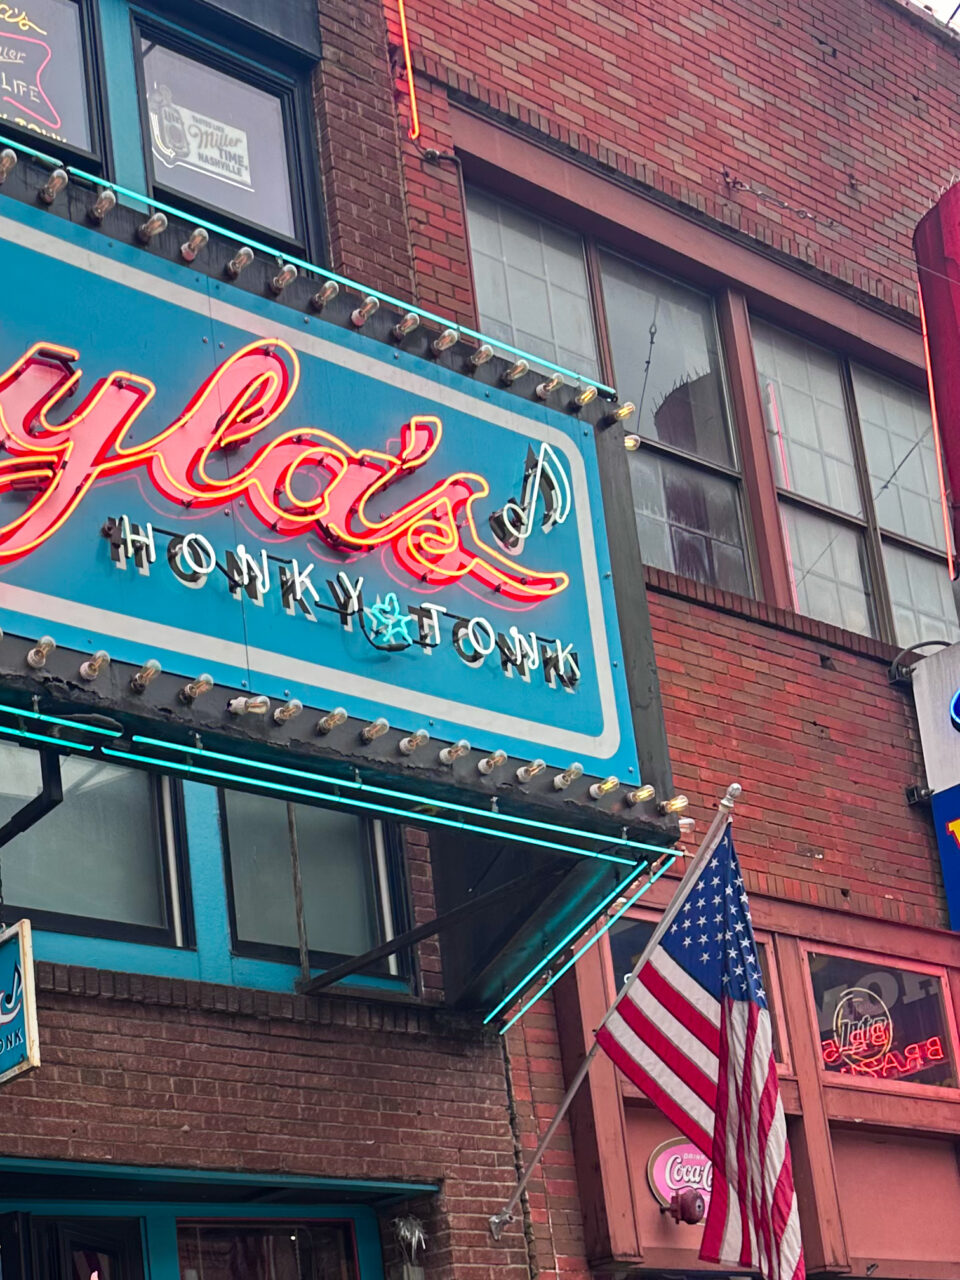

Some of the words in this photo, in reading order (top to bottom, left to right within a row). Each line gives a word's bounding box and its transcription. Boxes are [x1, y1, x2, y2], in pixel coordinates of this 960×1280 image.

[1, 71, 41, 103] LIFE
[188, 124, 243, 149] Miller
[198, 151, 243, 178] NASHVILLE
[102, 514, 366, 632] HONKY
[408, 602, 582, 693] TONK
